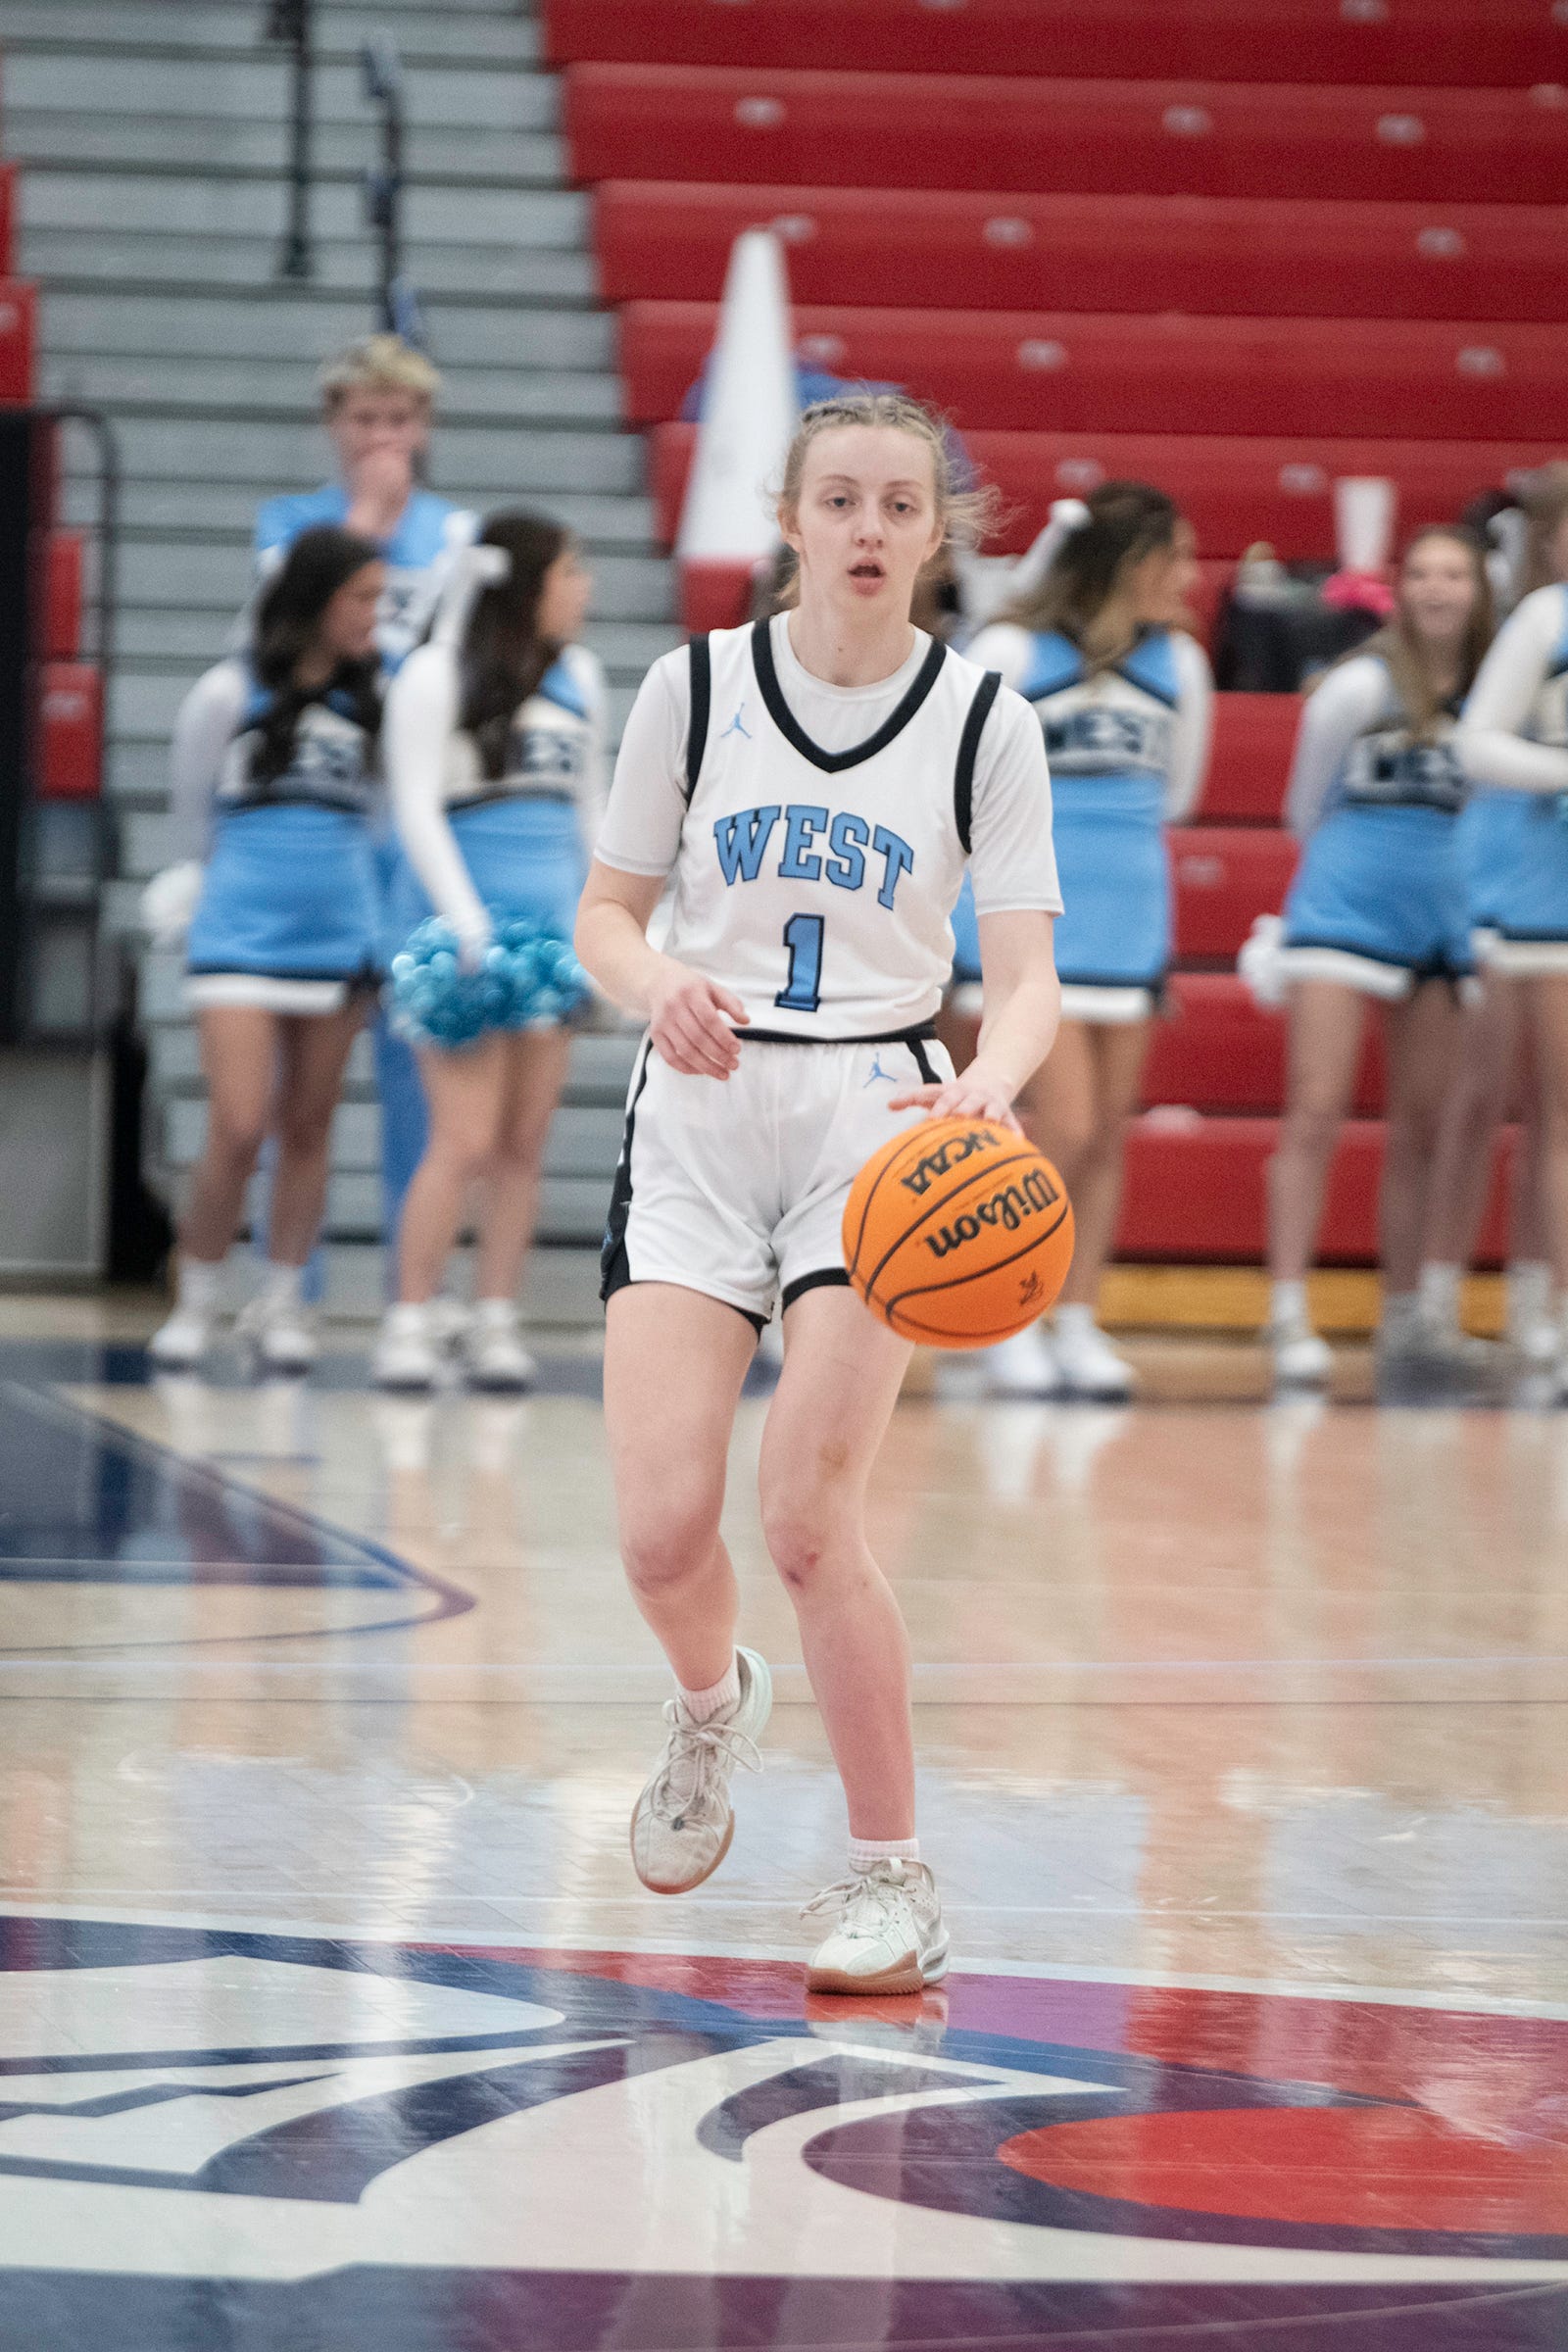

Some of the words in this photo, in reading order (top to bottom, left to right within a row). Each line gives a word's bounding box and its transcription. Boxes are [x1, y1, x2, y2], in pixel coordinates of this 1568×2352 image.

[713, 805, 914, 911] WEST
[774, 912, 825, 1012] 1
[901, 1129, 1002, 1196] NCAA
[924, 1168, 1059, 1258] Wilson
